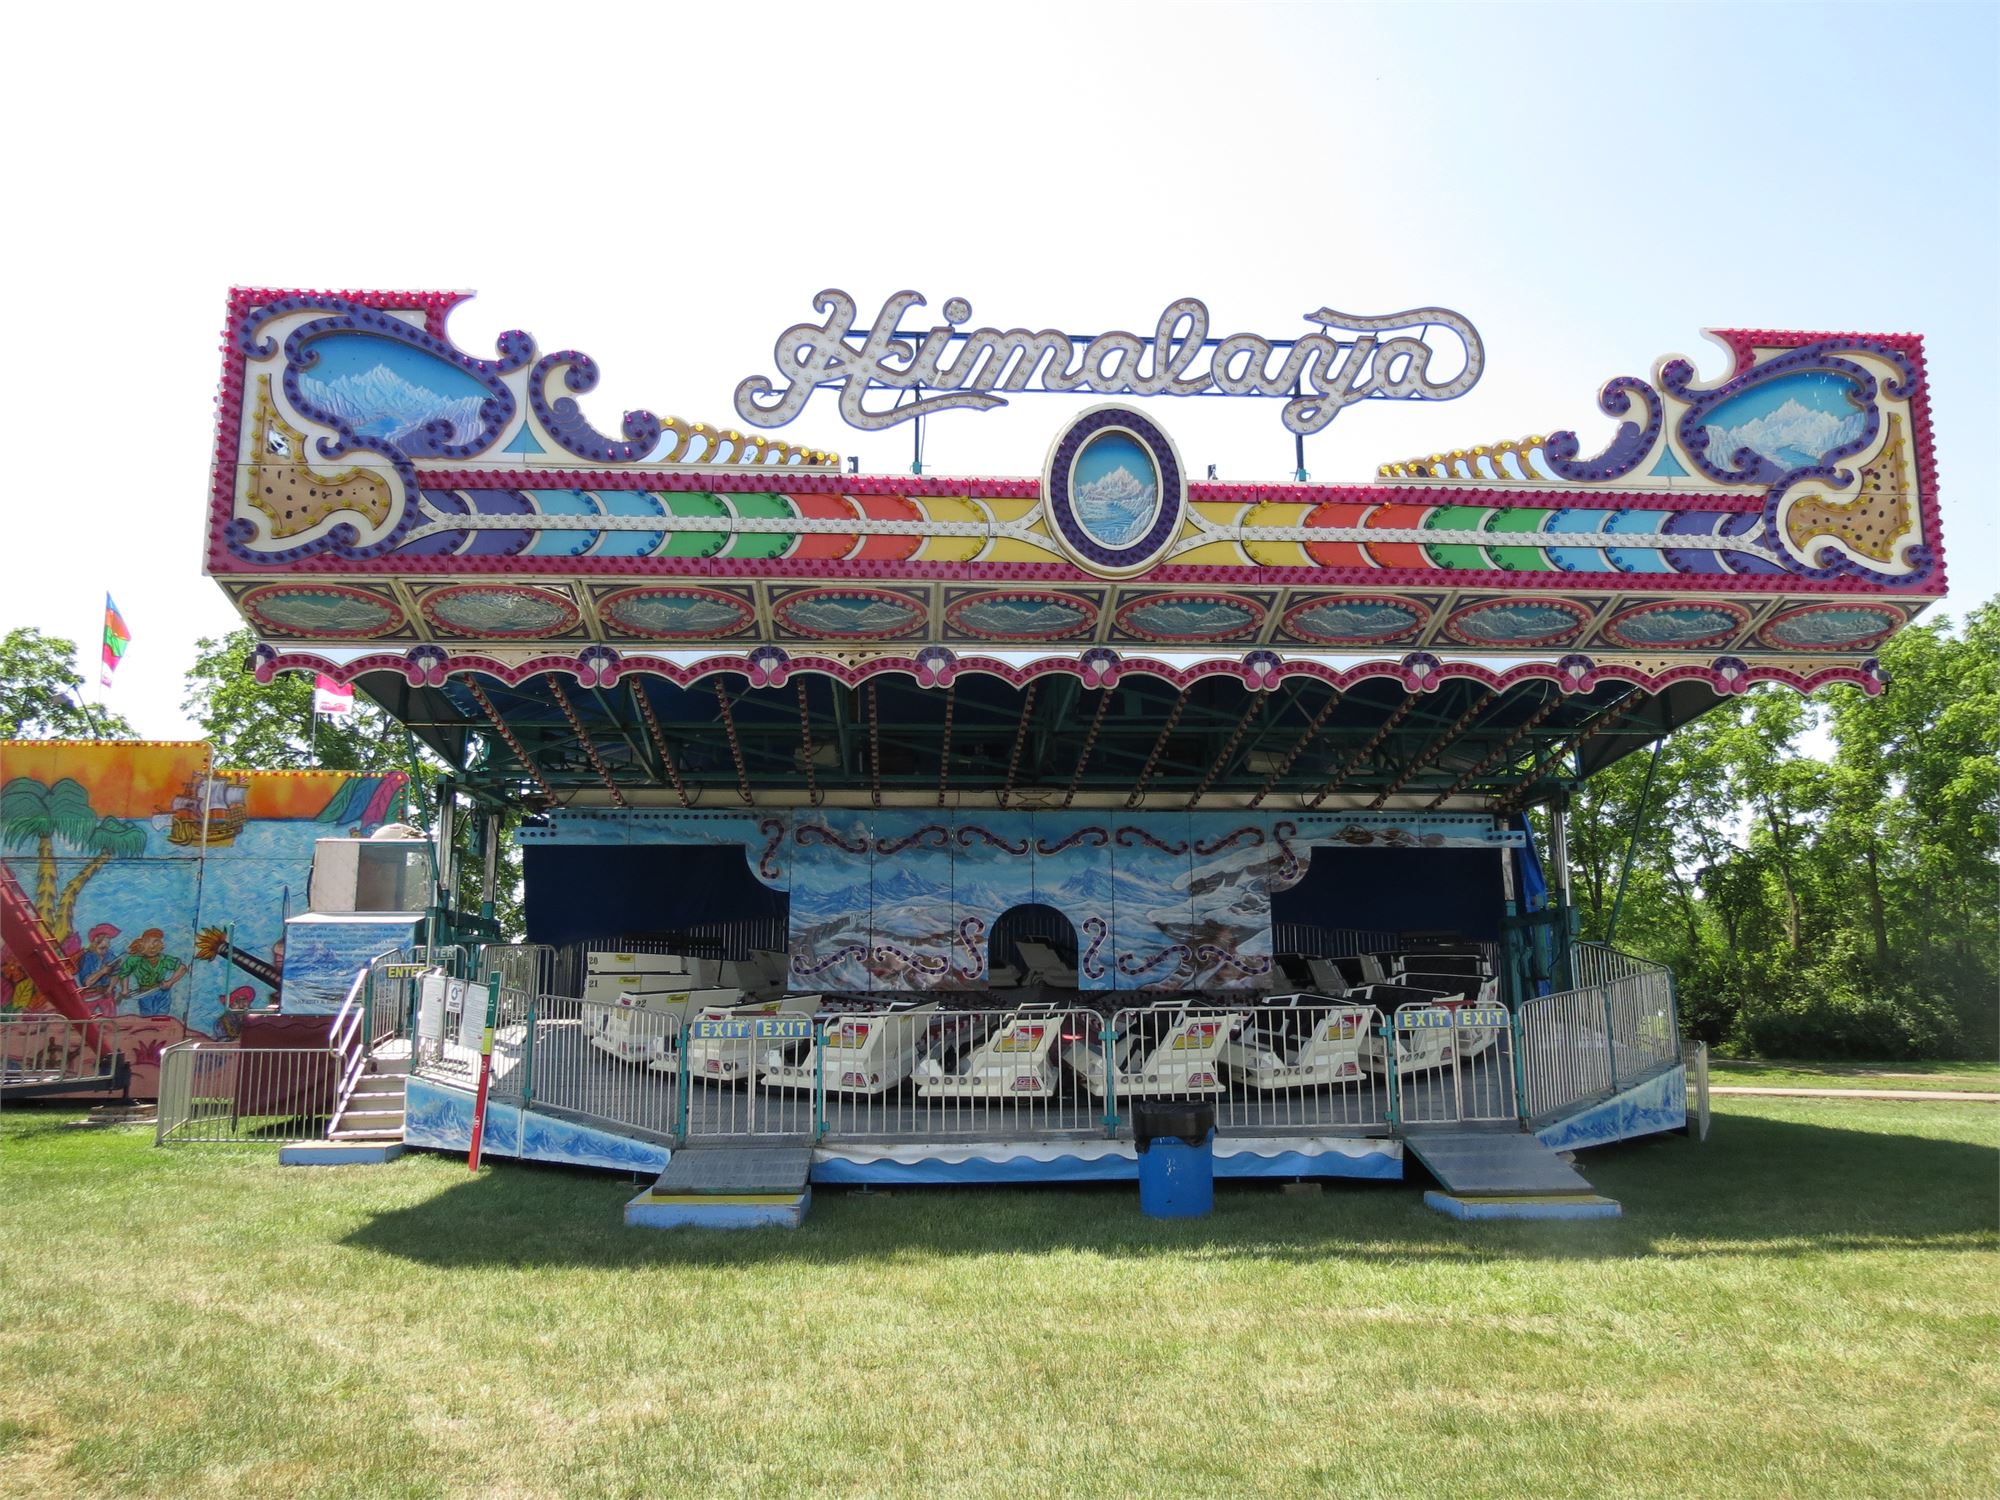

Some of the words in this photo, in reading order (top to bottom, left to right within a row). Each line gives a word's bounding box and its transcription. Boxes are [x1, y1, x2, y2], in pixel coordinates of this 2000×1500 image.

[734, 288, 1485, 435] Himalaya
[421, 949, 454, 959] ETER
[588, 956, 599, 966] 20
[588, 979, 599, 988] 21
[1403, 1013, 1446, 1027] EXIT
[1462, 1011, 1503, 1026] EXIT
[701, 1023, 745, 1038] EXIT
[762, 1021, 807, 1037] EXIT
